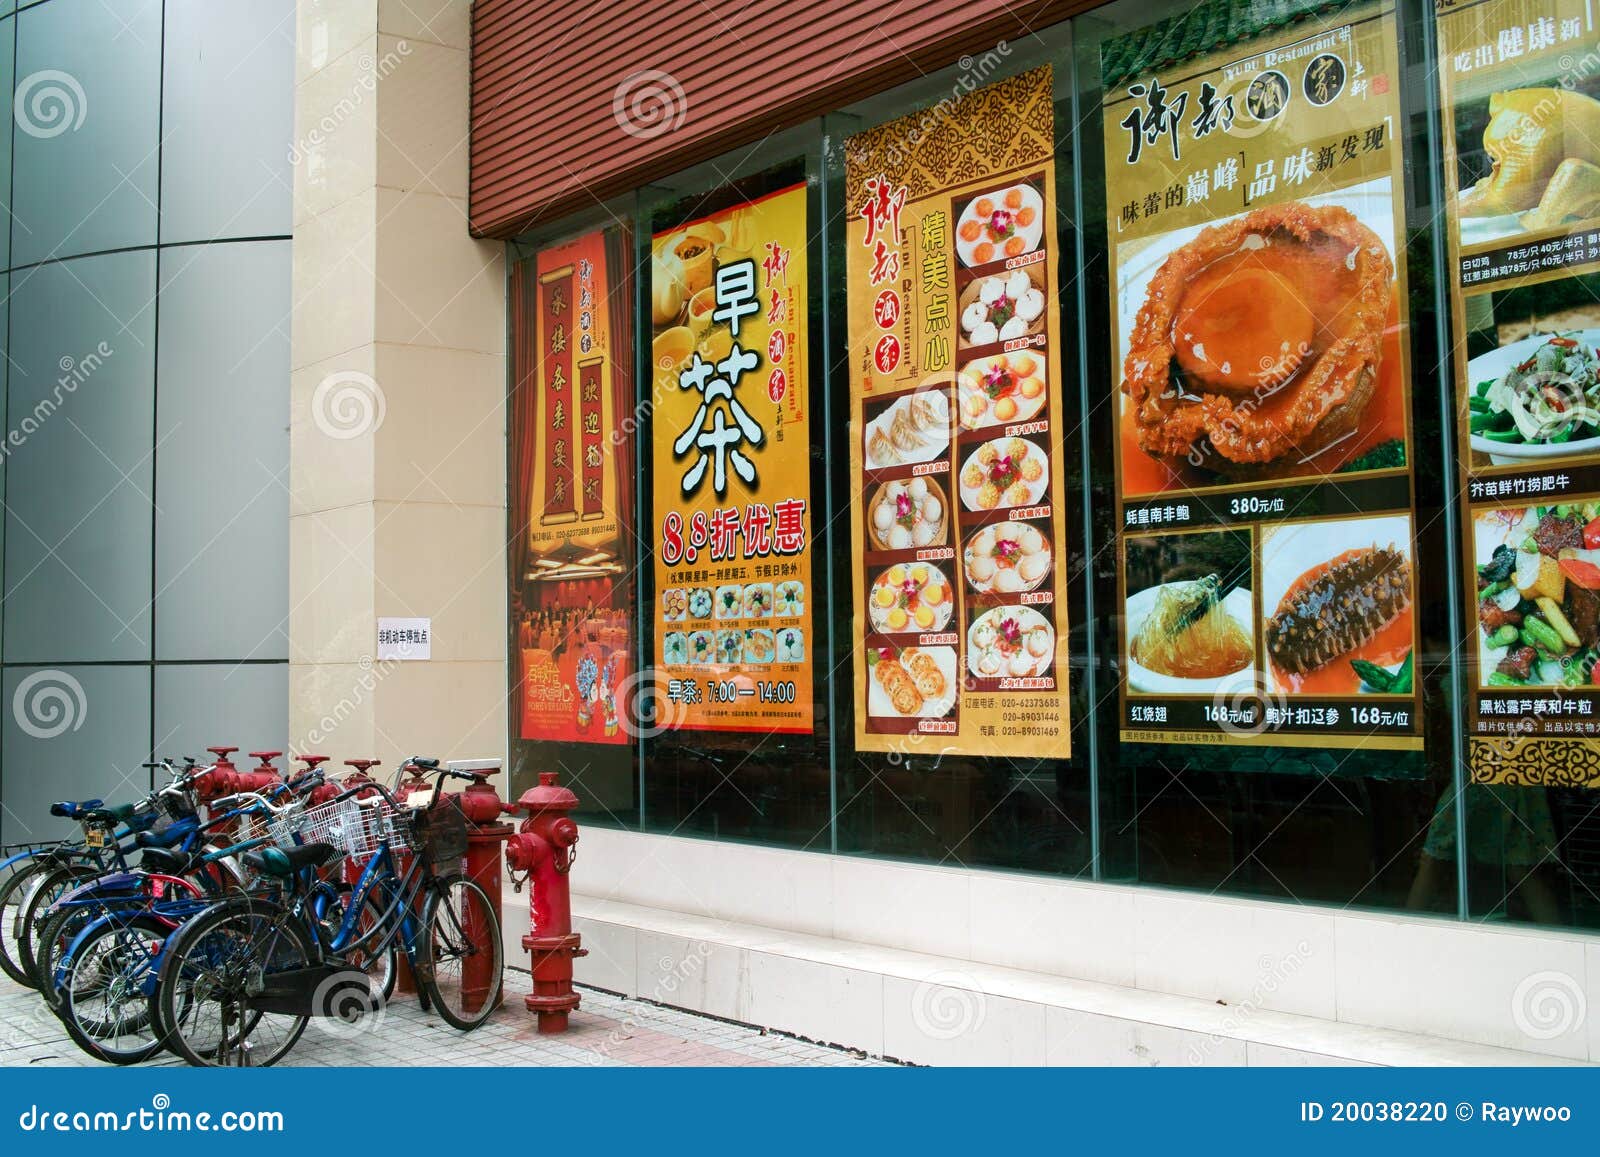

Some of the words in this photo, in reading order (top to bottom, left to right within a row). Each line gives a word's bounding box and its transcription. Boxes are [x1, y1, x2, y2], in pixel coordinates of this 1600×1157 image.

[1265, 34, 1337, 67] Restaurant
[1462, 257, 1490, 270] 白切鸡
[1507, 245, 1540, 260] 78元/只
[1541, 236, 1583, 253] 40元/半只
[1541, 249, 1584, 266] 40元/半只
[921, 210, 950, 372] 精美点心
[902, 278, 912, 367] Restaurant
[674, 257, 764, 494] 早茶
[1471, 474, 1570, 497] 芥苗鲜竹捞肥牛
[1126, 505, 1190, 525] 蚝皇南非鲍
[1231, 497, 1284, 515] 380元/位
[661, 498, 806, 567] 8.8折优惠
[379, 629, 428, 644] 非机动车停放点
[1001, 698, 1060, 708] 020-62373688
[1480, 699, 1593, 715] 黑松露芦笋和牛粒
[1002, 712, 1060, 722] 020-89031446
[1131, 706, 1167, 722] 红烧翅
[1204, 706, 1254, 723] 168元/位
[1266, 707, 1340, 725] 鲍汁扣辽参
[1351, 707, 1409, 725] 168元/位
[1001, 726, 1060, 736] 020-89031469
